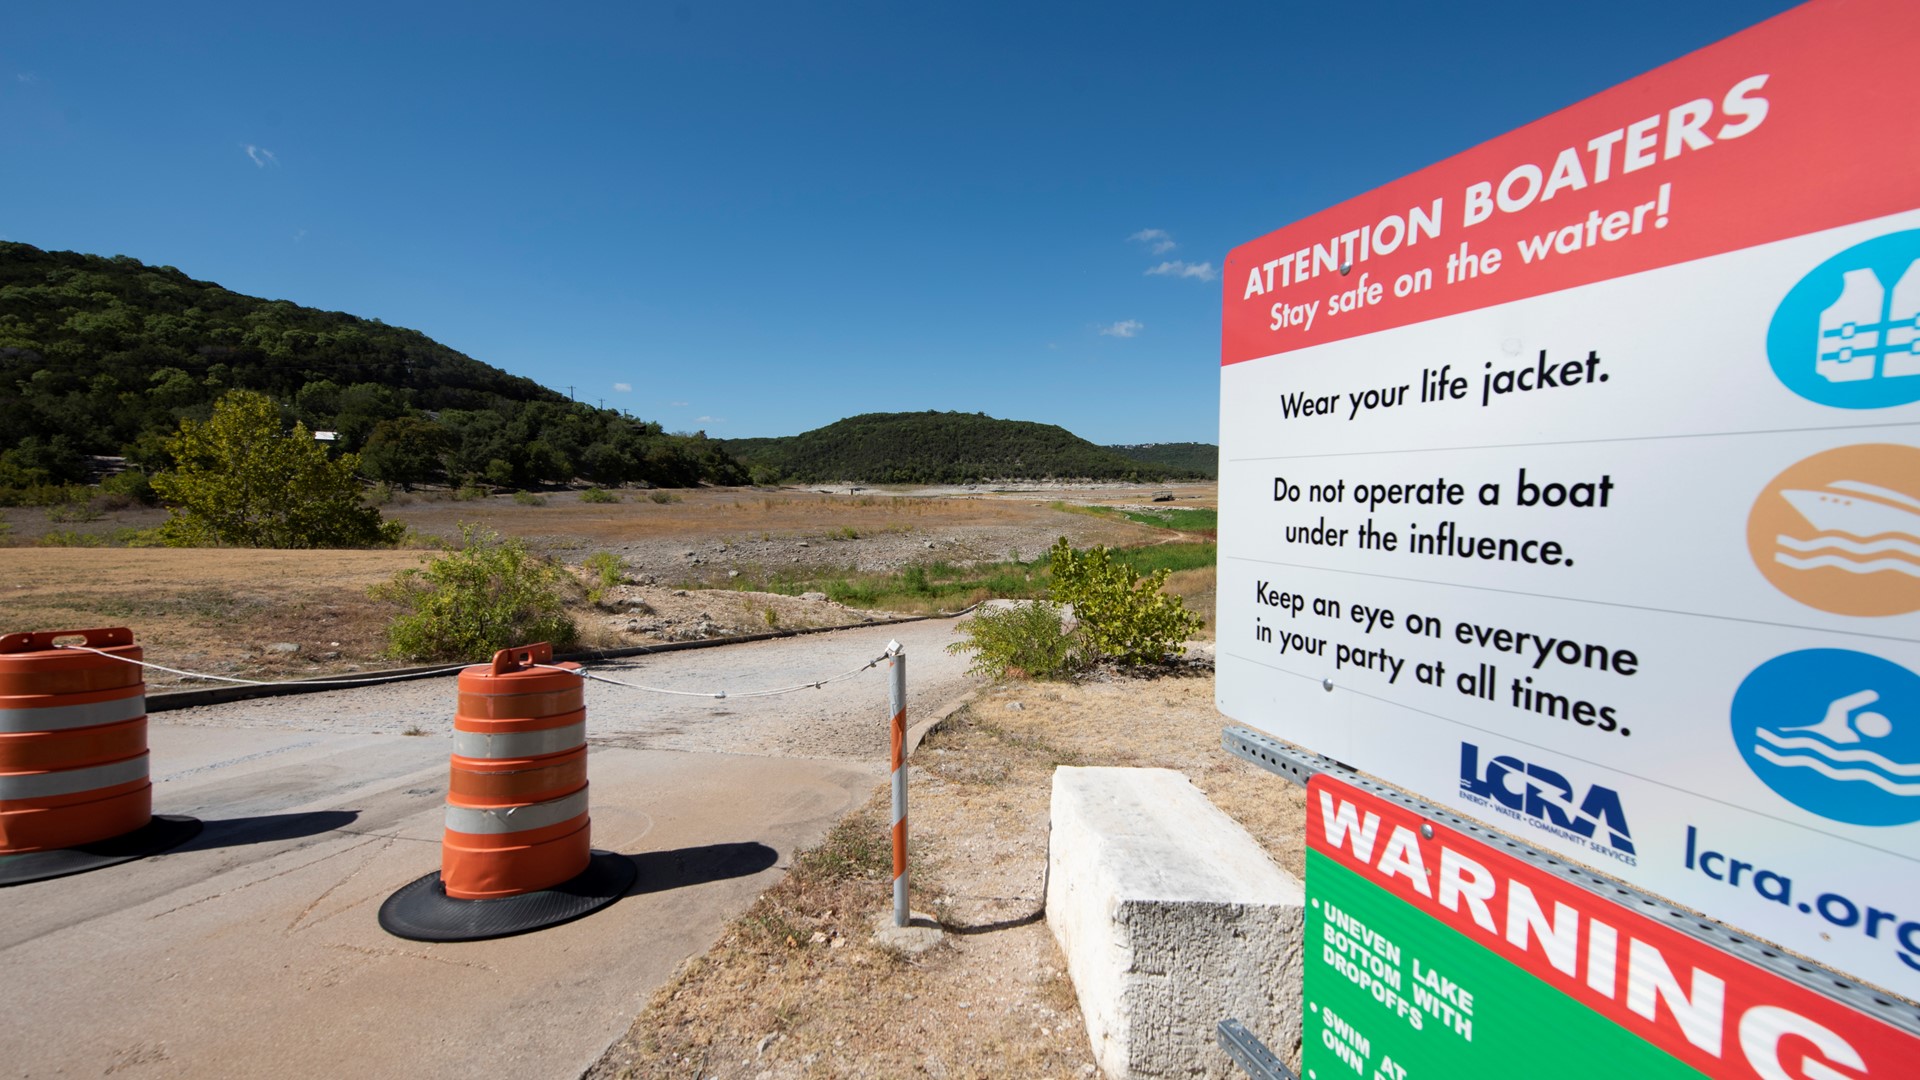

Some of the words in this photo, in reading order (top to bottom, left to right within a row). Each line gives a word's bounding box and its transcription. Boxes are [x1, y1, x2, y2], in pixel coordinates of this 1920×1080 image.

[1243, 197, 1443, 300] ATTENTION
[1462, 73, 1770, 228] BOATERS
[1269, 298, 1319, 333] Stay
[1327, 272, 1383, 317] safe
[1394, 265, 1432, 299] on
[1446, 241, 1502, 285] the
[1516, 181, 1672, 264] water!
[1280, 390, 1340, 420] Wear
[1348, 382, 1410, 420] your
[1421, 365, 1468, 403] life
[1481, 349, 1610, 407] jacket.
[1273, 477, 1301, 503] Do
[1309, 479, 1345, 503] not
[1353, 476, 1465, 513] operate
[1478, 487, 1500, 506] a
[1516, 467, 1614, 508] boat
[1285, 516, 1349, 549] under
[1358, 518, 1398, 552] the
[1409, 521, 1575, 567] influence.
[1256, 580, 1305, 618] Keep
[1312, 599, 1341, 620] an
[1350, 605, 1395, 634] eye
[1405, 613, 1442, 639] on
[1454, 621, 1640, 677] everyone
[1256, 617, 1273, 644] in
[1279, 628, 1328, 656] your
[1335, 641, 1405, 685] party
[1415, 659, 1446, 689] at
[1456, 663, 1496, 702] all
[1511, 676, 1632, 737] times.
[1459, 741, 1637, 856] LCRA
[1459, 790, 1489, 809] ENERGY
[1494, 804, 1522, 822] WATER
[1528, 818, 1587, 847] COMMUNITY
[1590, 841, 1637, 867] SERVICES
[1318, 789, 1869, 1080] WARNING
[1323, 922, 1401, 992] BOTTOM
[1412, 981, 1473, 1042] WITH
[1324, 901, 1401, 967] UNEVEN
[1412, 958, 1474, 1017] LAKE
[1322, 943, 1424, 1031] DROPOFFS
[1321, 1028, 1364, 1076] OWN
[1322, 1006, 1371, 1059] SWIM
[1380, 1054, 1408, 1080] AT
